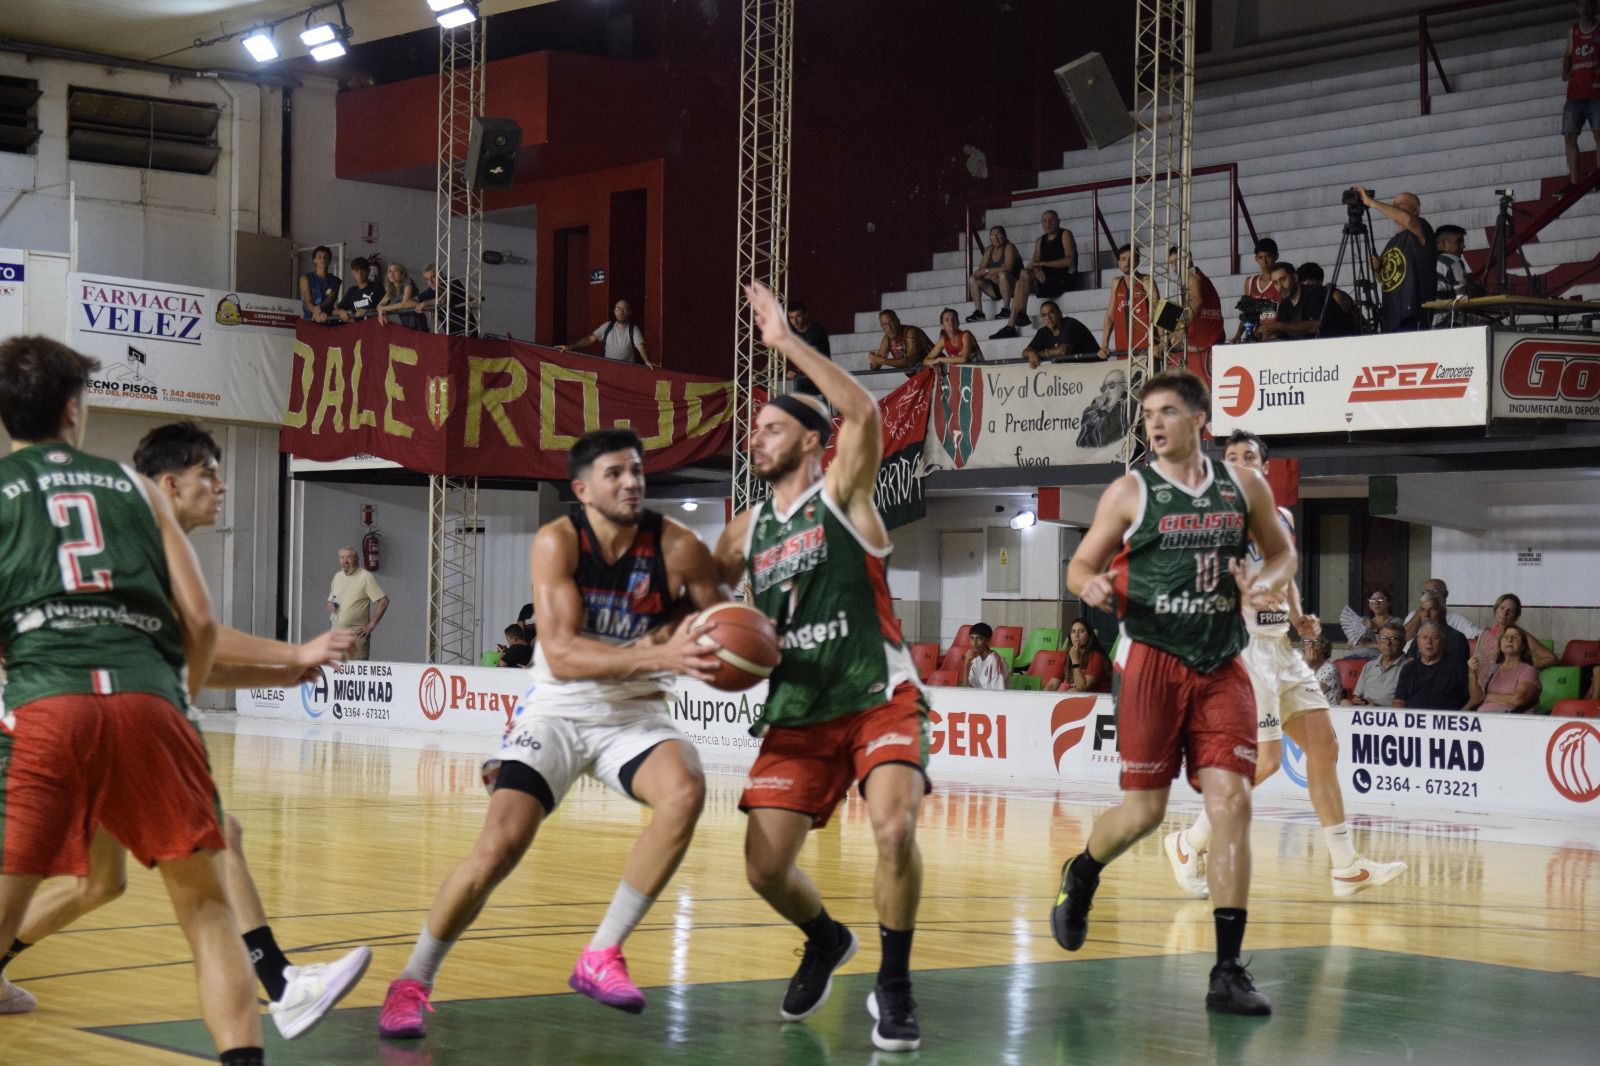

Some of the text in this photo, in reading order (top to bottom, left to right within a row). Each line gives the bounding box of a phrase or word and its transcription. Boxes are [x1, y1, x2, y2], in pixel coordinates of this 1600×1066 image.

[0, 266, 16, 280] O
[82, 285, 203, 315] FARMACIA
[81, 303, 203, 341] VELEZ
[1259, 365, 1339, 386] Electricidad
[1352, 362, 1438, 389] APEZ
[122, 383, 158, 395] PISOS
[283, 338, 418, 439] DALE
[987, 371, 1083, 406] Voy al Coliseo
[1257, 386, 1305, 411] Junín
[1509, 403, 1572, 414] INDUMENTARIA
[988, 410, 1080, 433] a Prenderme
[3, 472, 132, 499] DI PRINZIO
[47, 492, 113, 593] 2
[784, 611, 849, 650] ngeri
[334, 664, 393, 677] AGUA DE MESA
[251, 688, 285, 702] VALEAS
[333, 679, 393, 703] MIGUI HAD
[1351, 711, 1483, 733] AGUA DE MESA
[926, 711, 1008, 760] GERI
[1091, 754, 1121, 764] FERRE
[1351, 733, 1485, 772] MIGUI HAD
[1376, 775, 1411, 793] 2364
[1425, 778, 1478, 798] 673221
